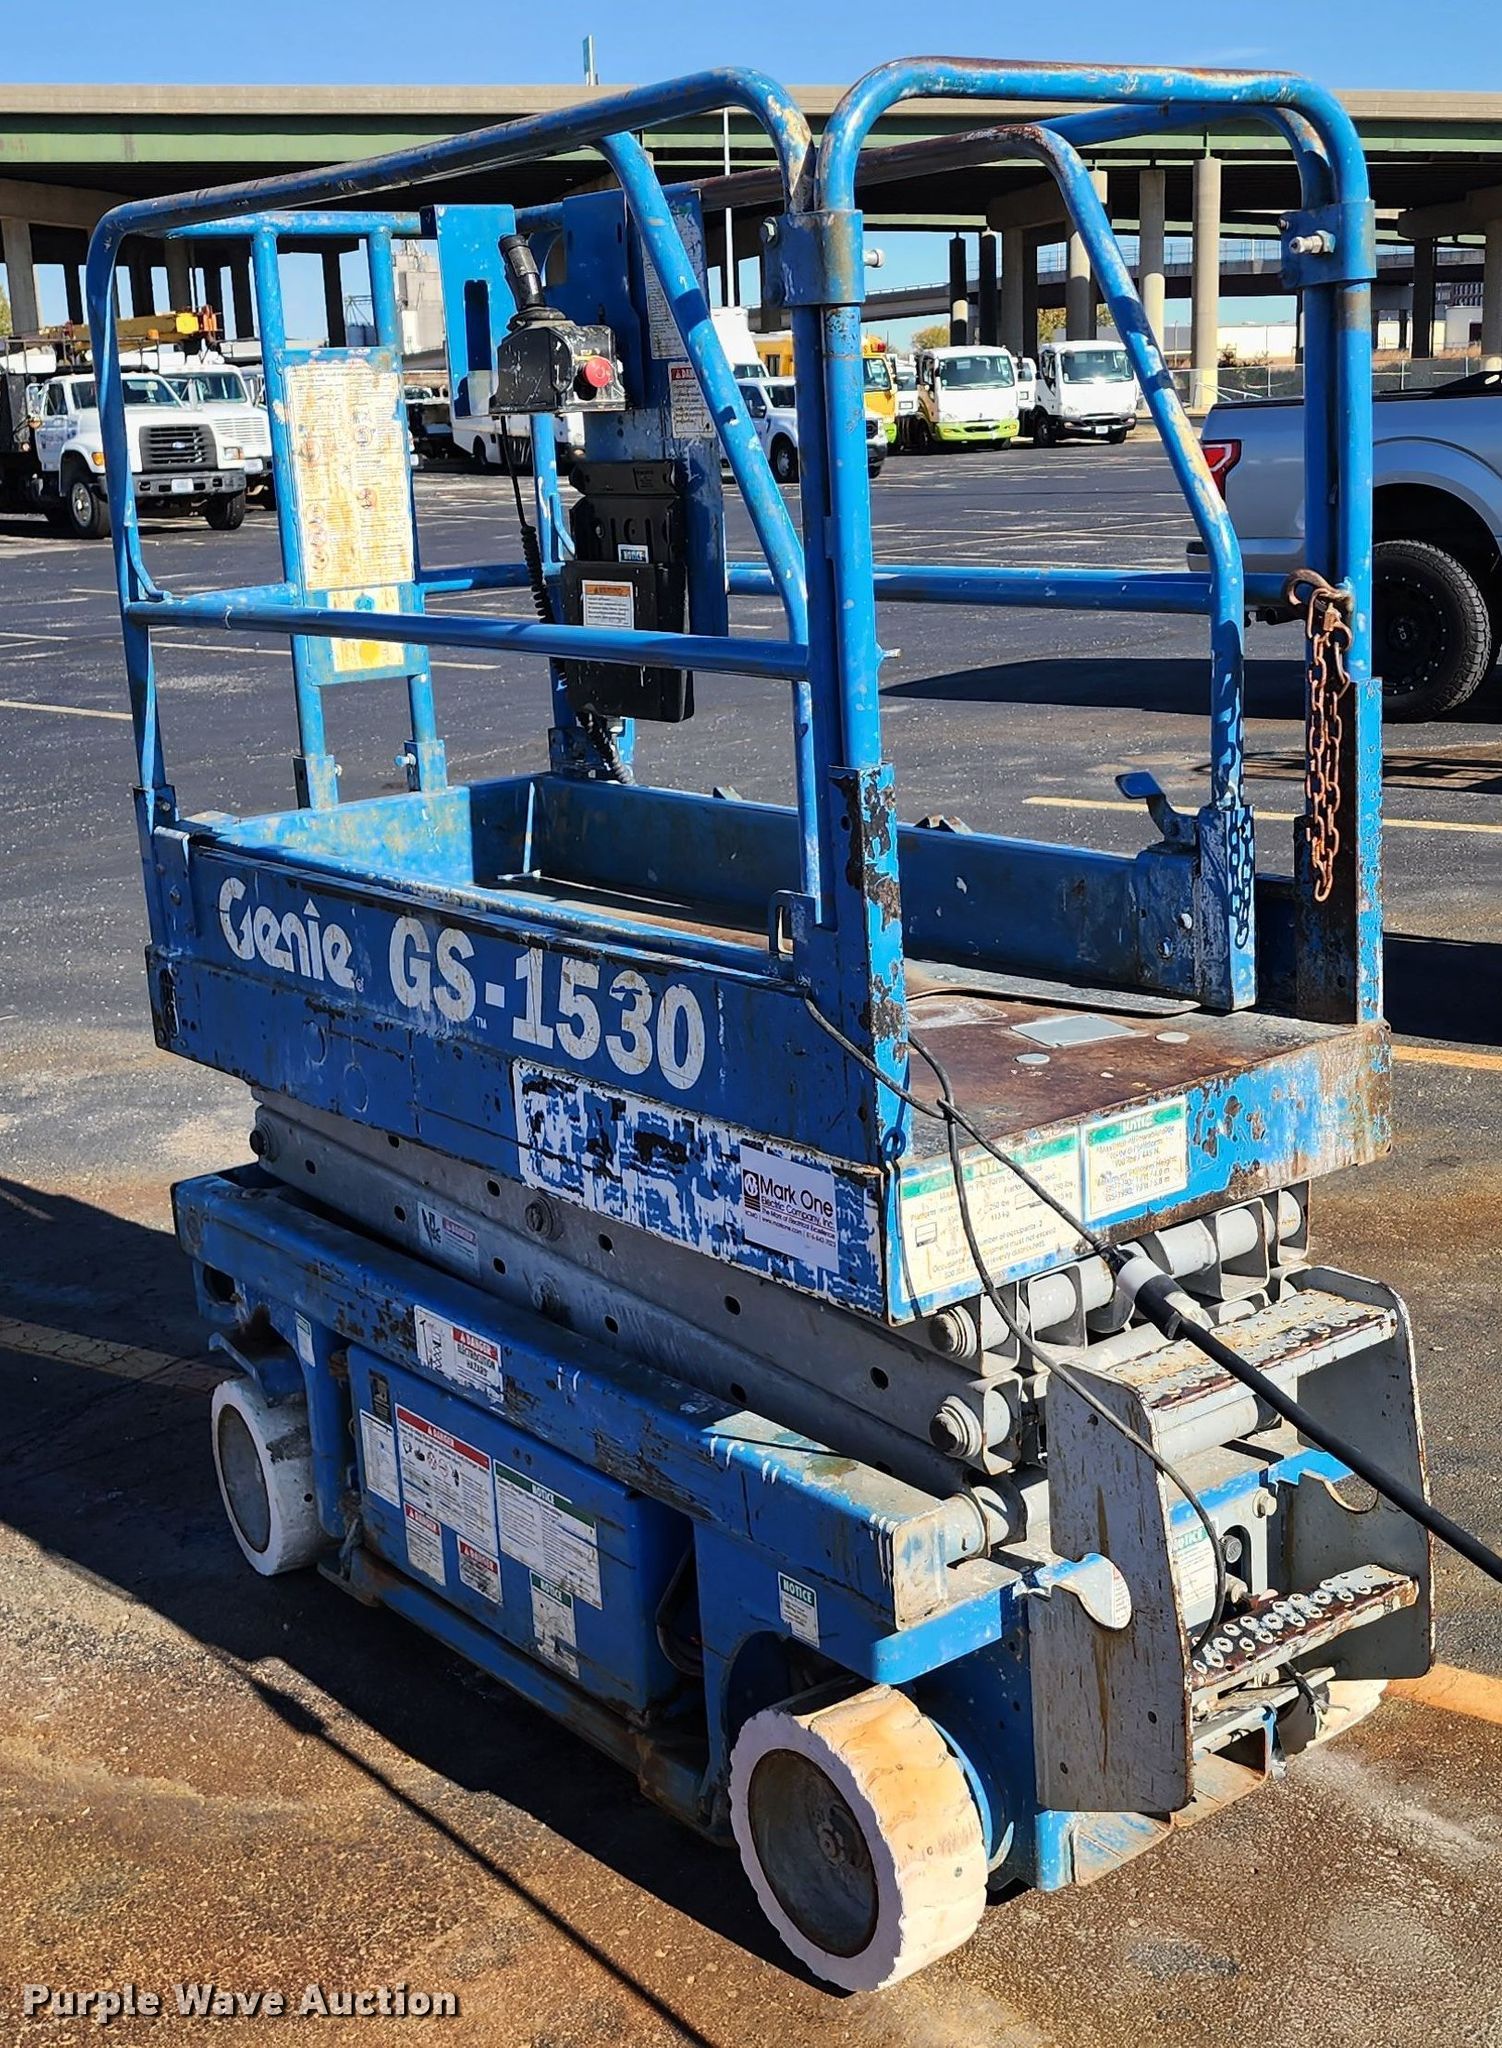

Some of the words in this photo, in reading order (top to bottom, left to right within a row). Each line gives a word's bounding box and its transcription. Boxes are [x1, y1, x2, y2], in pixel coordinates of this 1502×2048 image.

[219, 877, 355, 989] Genie
[389, 916, 705, 1090] GS-1530
[759, 1174, 797, 1206] Mark
[799, 1187, 833, 1219] One
[761, 1195, 784, 1211] Electric
[822, 1217, 835, 1229] Inc.
[532, 1483, 556, 1505] NOTICE
[540, 1579, 562, 1601] NOTICE
[783, 1579, 812, 1604] NOTICE
